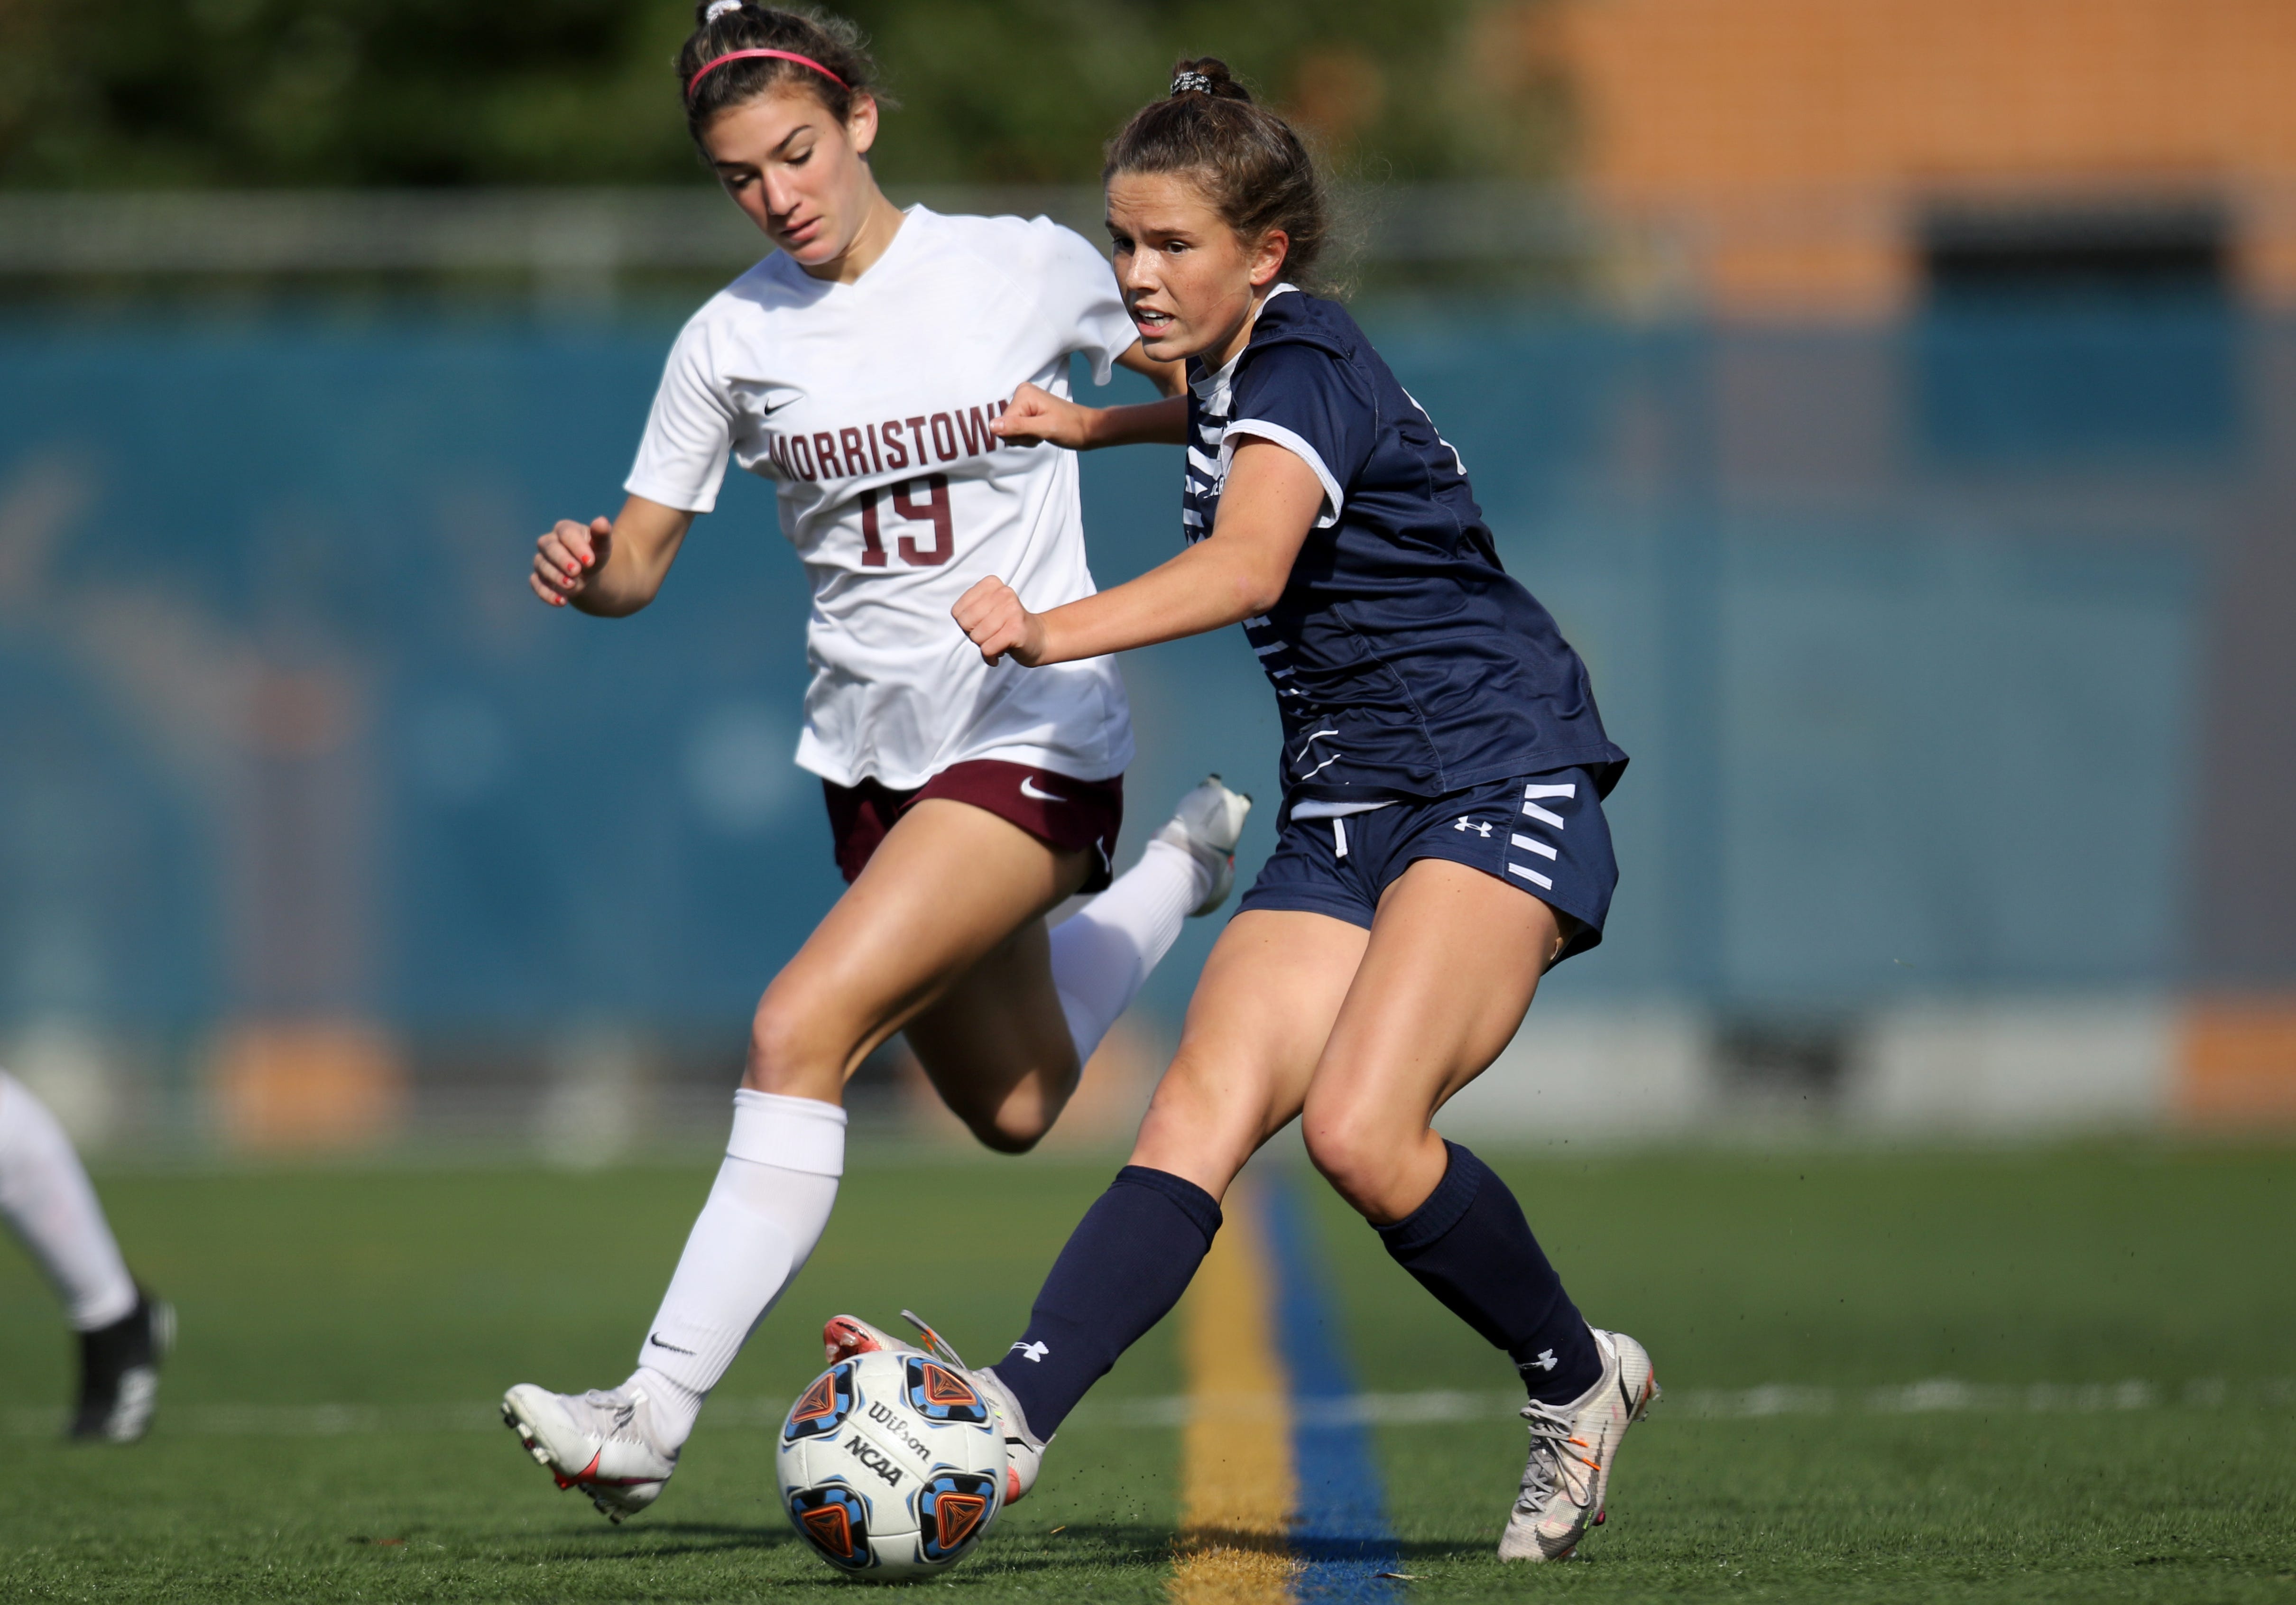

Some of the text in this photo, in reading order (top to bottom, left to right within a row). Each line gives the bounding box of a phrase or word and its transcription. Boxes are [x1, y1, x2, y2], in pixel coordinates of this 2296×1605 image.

[860, 473, 955, 567] 19
[844, 1435, 904, 1487] NCAA
[868, 1400, 931, 1463] Wilson
